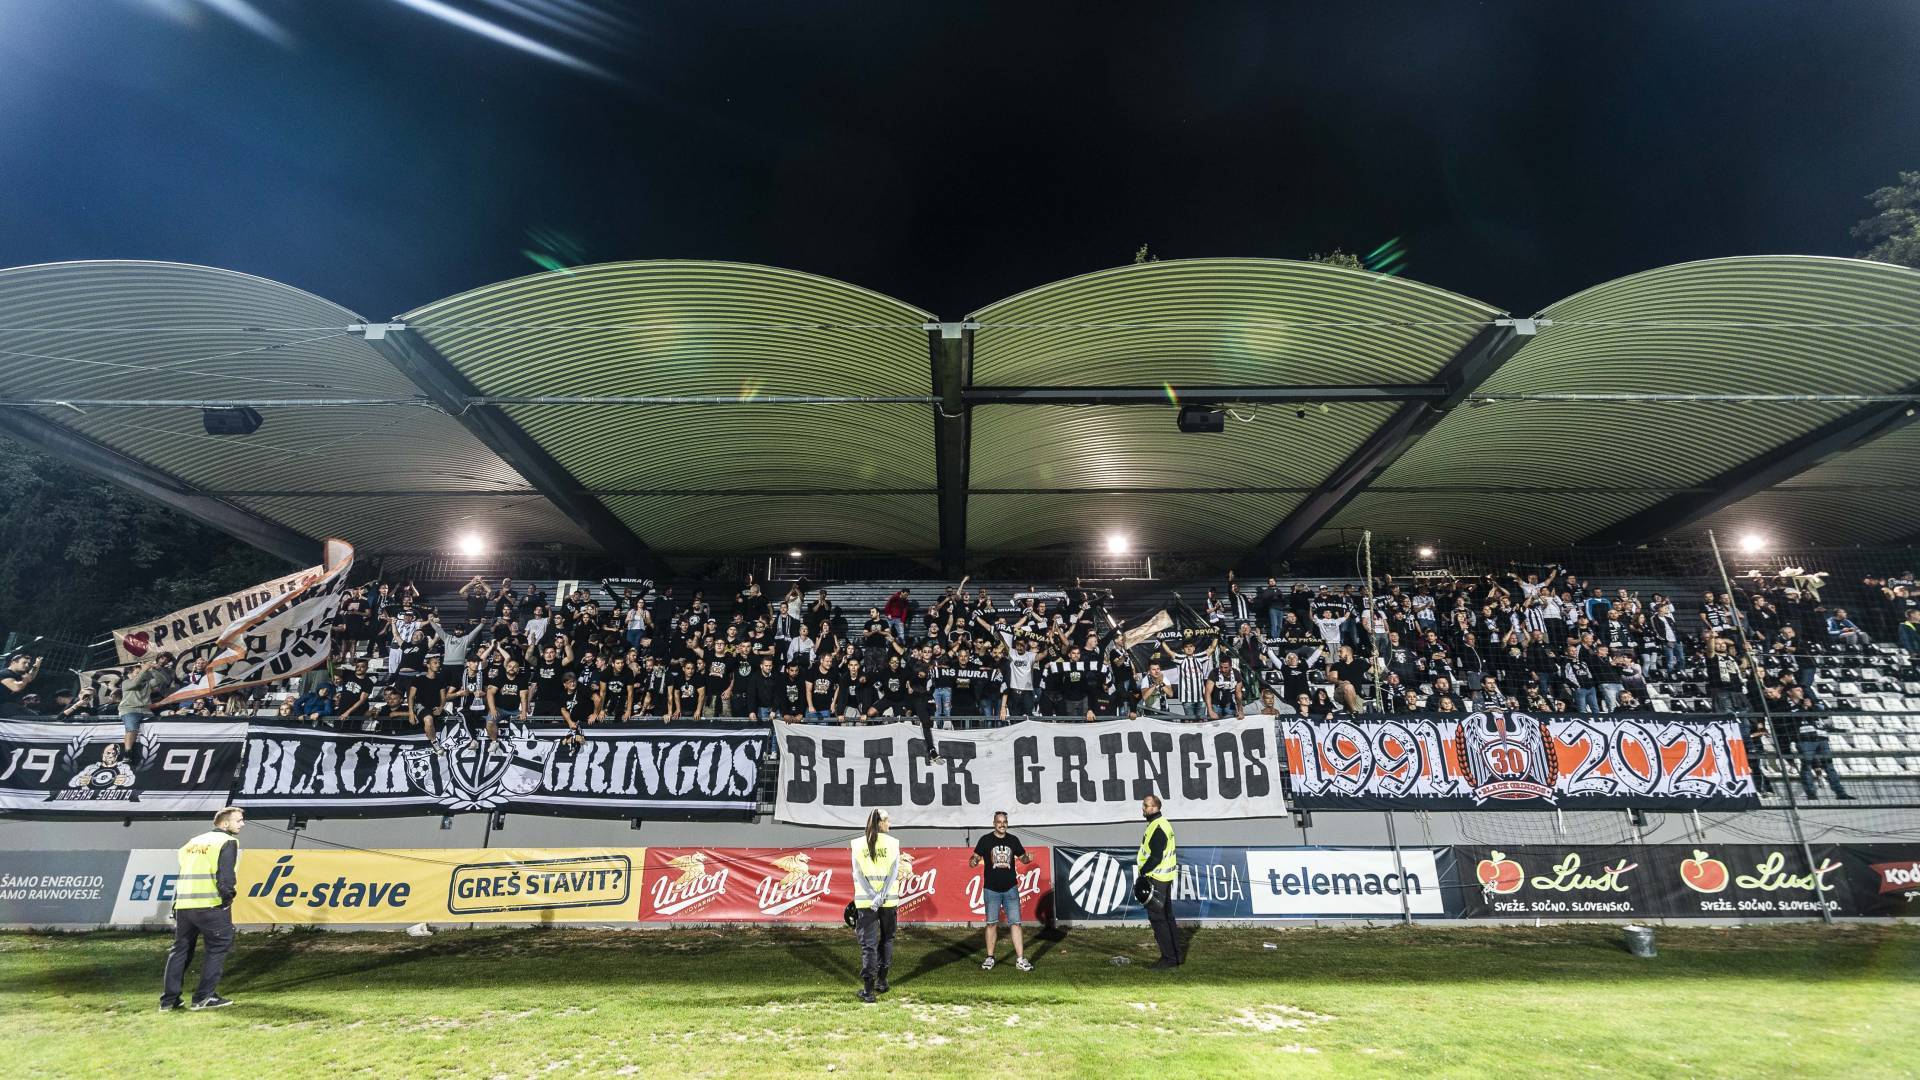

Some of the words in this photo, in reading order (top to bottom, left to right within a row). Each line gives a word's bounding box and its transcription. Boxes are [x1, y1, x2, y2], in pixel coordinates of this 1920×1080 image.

[958, 669, 989, 679] MURA
[0, 748, 60, 783] 19
[163, 748, 216, 784] 91
[239, 738, 415, 795] BLACK
[542, 739, 763, 797] GRINGOS
[786, 734, 981, 807] BLACK
[1014, 728, 1270, 805] GRINGOS
[1289, 719, 1460, 797] 1991
[1491, 748, 1525, 774] 30
[1557, 718, 1748, 797] 2021
[56, 789, 95, 800] MURSKA
[96, 789, 132, 800] SOBOTA
[1481, 783, 1509, 794] BLACK
[40, 875, 104, 889] ENERGIJO,
[458, 872, 521, 898] GREŠ
[526, 869, 623, 894] STAVIT?
[899, 868, 937, 897] ion
[1268, 866, 1422, 895] telemach
[1531, 852, 1639, 892] Lust
[1735, 851, 1843, 892] Lust
[28, 889, 102, 900] RAVNOVESJE.
[1494, 899, 1530, 912] SVEŽE.
[1531, 899, 1570, 912] SOČNO.
[1571, 901, 1635, 912] SLOVENSKO.
[1700, 898, 1737, 911] SVEŽE.
[1738, 899, 1778, 911] SOČNO.
